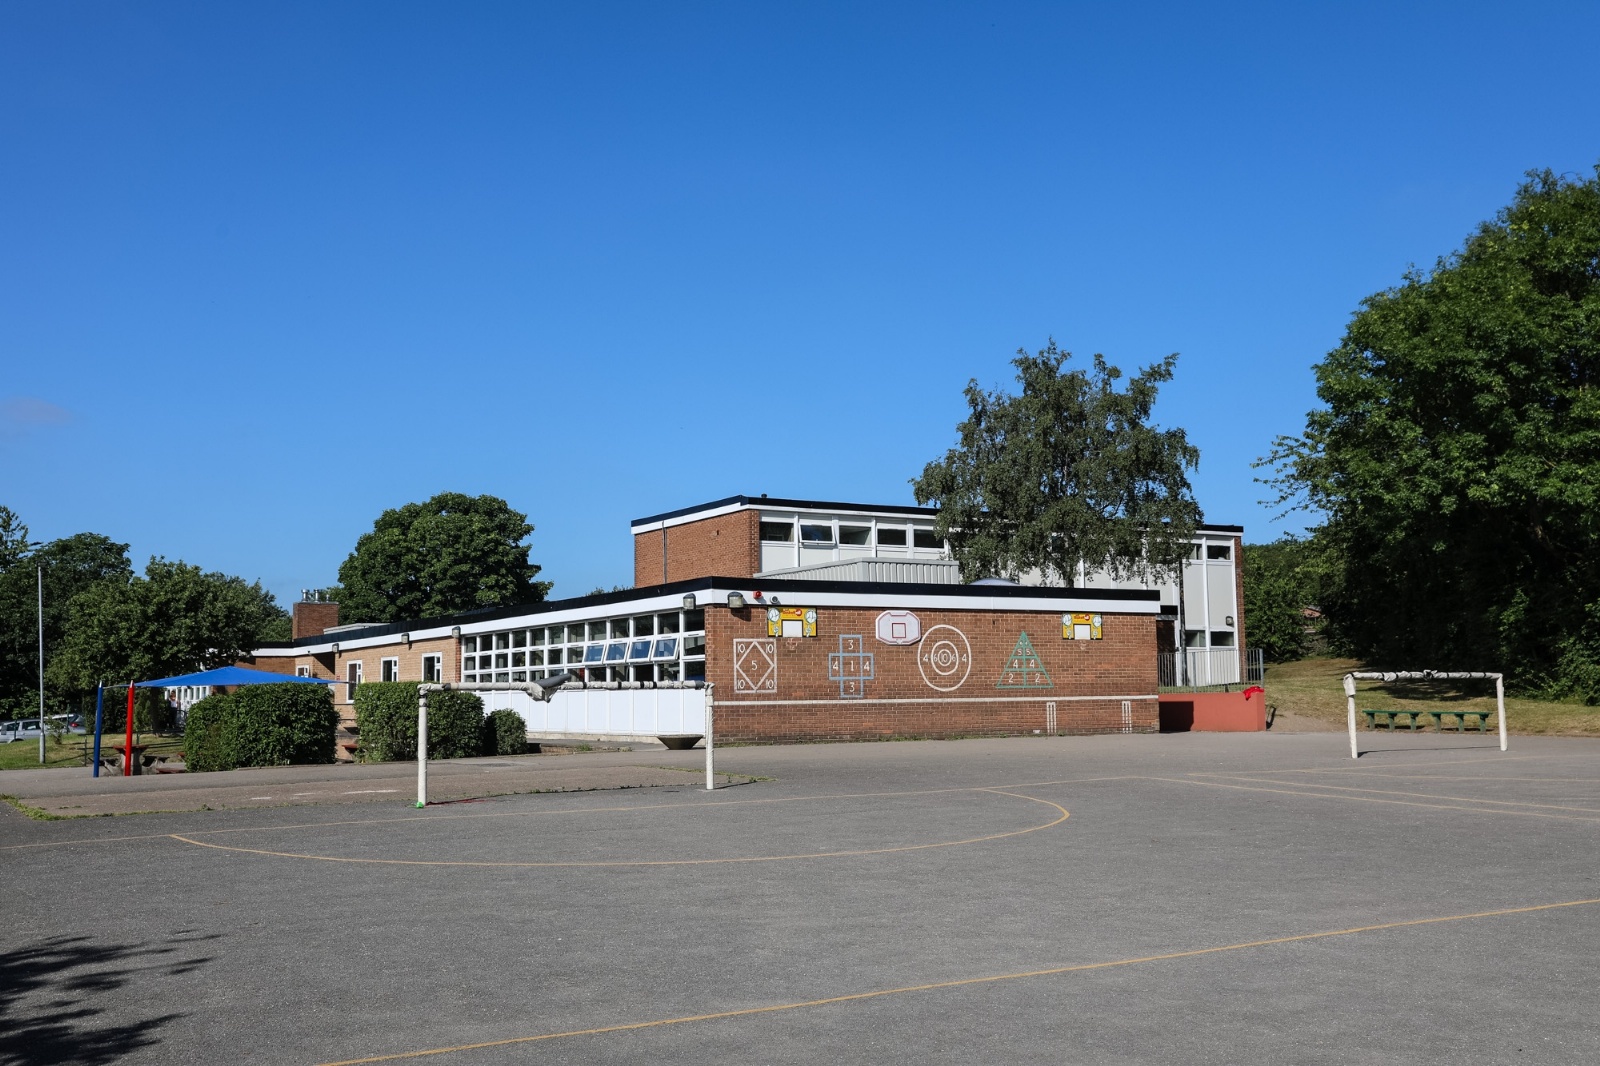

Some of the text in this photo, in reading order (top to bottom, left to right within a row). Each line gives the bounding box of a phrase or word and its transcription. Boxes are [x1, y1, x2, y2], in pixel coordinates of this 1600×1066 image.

[738, 643, 774, 654] 10 10
[848, 640, 854, 650] 3
[923, 654, 928, 662] 4
[962, 654, 966, 662] 4
[1013, 658, 1034, 668] 4 4
[752, 660, 758, 670] 5
[832, 660, 870, 672] 4 1 4
[1008, 673, 1040, 682] 2 2
[738, 679, 774, 689] 10 10
[850, 682, 854, 692] 3
